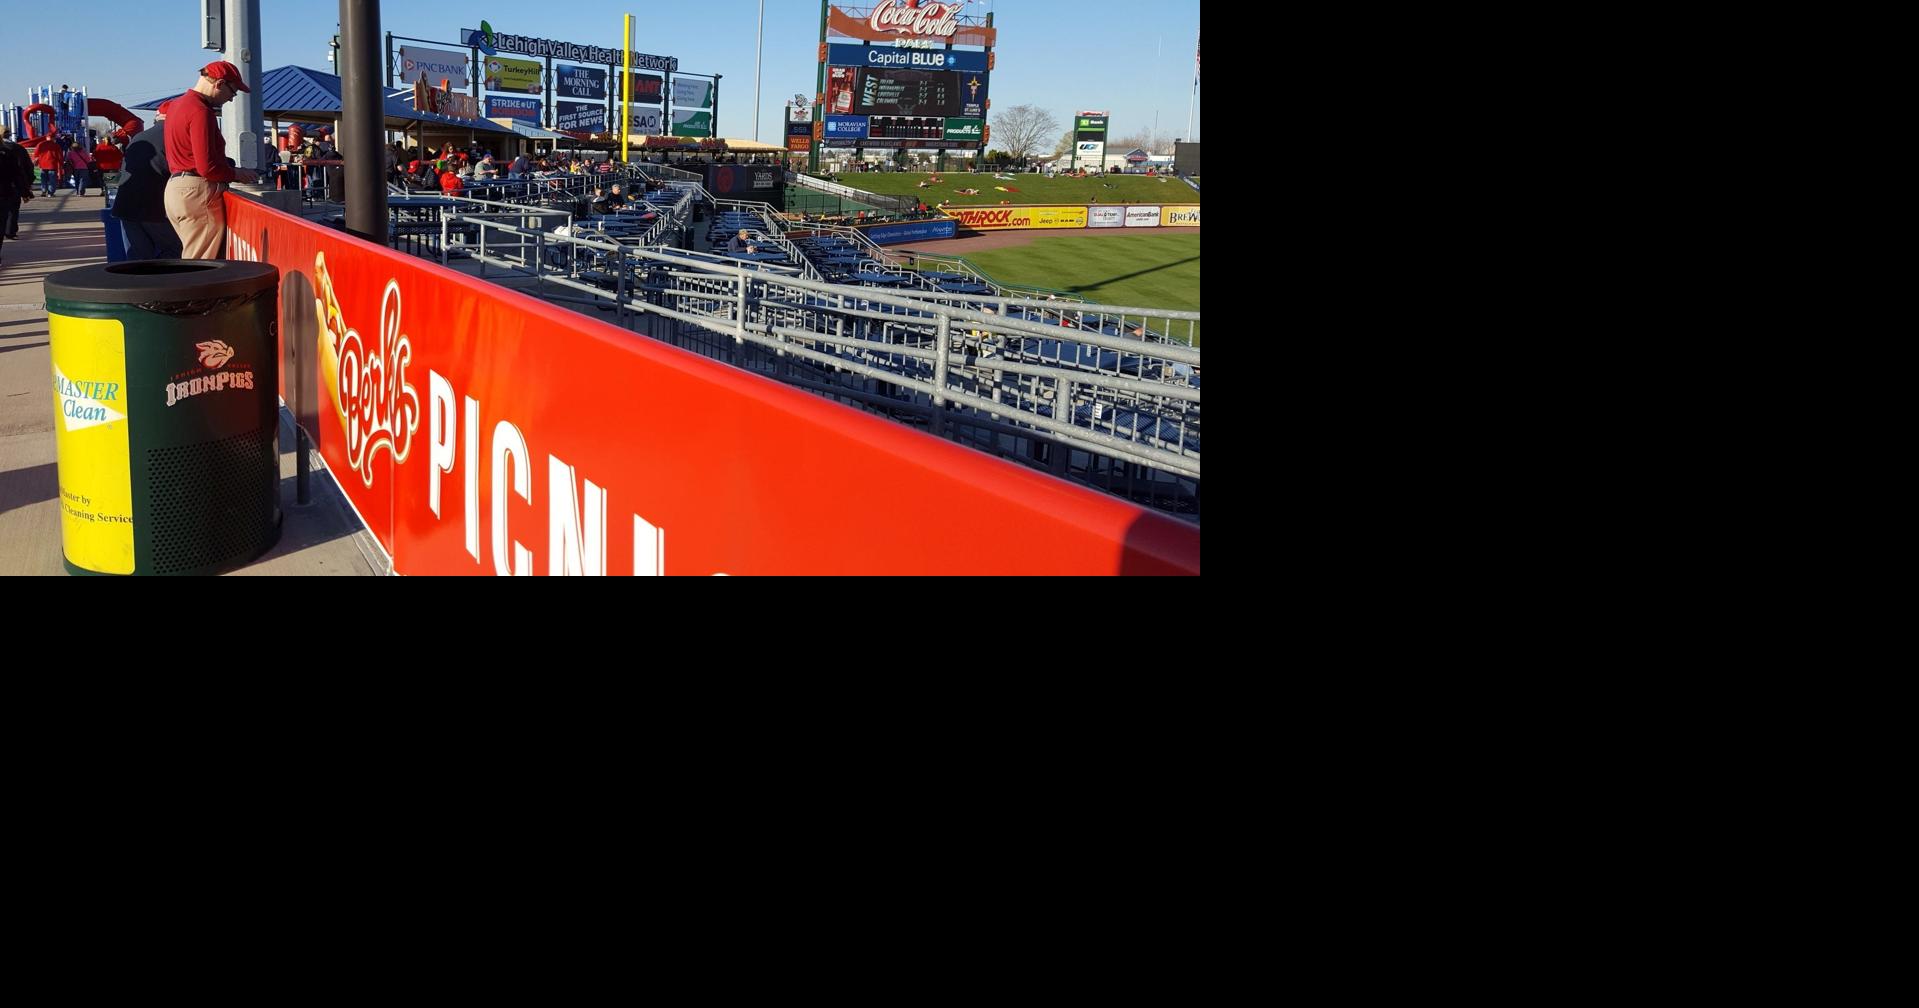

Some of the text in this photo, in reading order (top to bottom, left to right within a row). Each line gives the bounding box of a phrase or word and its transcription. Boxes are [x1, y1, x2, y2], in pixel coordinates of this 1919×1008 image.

[870, 0, 963, 37] Coca-Cola
[498, 32, 546, 57] Lehigh
[548, 39, 585, 63] Valley
[630, 51, 676, 70] Network
[868, 50, 910, 66] Capital
[574, 69, 590, 79] THE
[563, 77, 600, 89] MORNING
[862, 74, 879, 106] WEST
[572, 87, 592, 97] CALL
[491, 98, 520, 108] STRIKE
[559, 109, 604, 122] FIRST SOURCE
[559, 115, 603, 131] FOR NEWS
[1169, 212, 1200, 224] BREW
[337, 278, 420, 489] Berks
[63, 399, 107, 422] Clean
[430, 368, 735, 576] PICN
[81, 495, 91, 507] by
[64, 504, 95, 522] Cleaning
